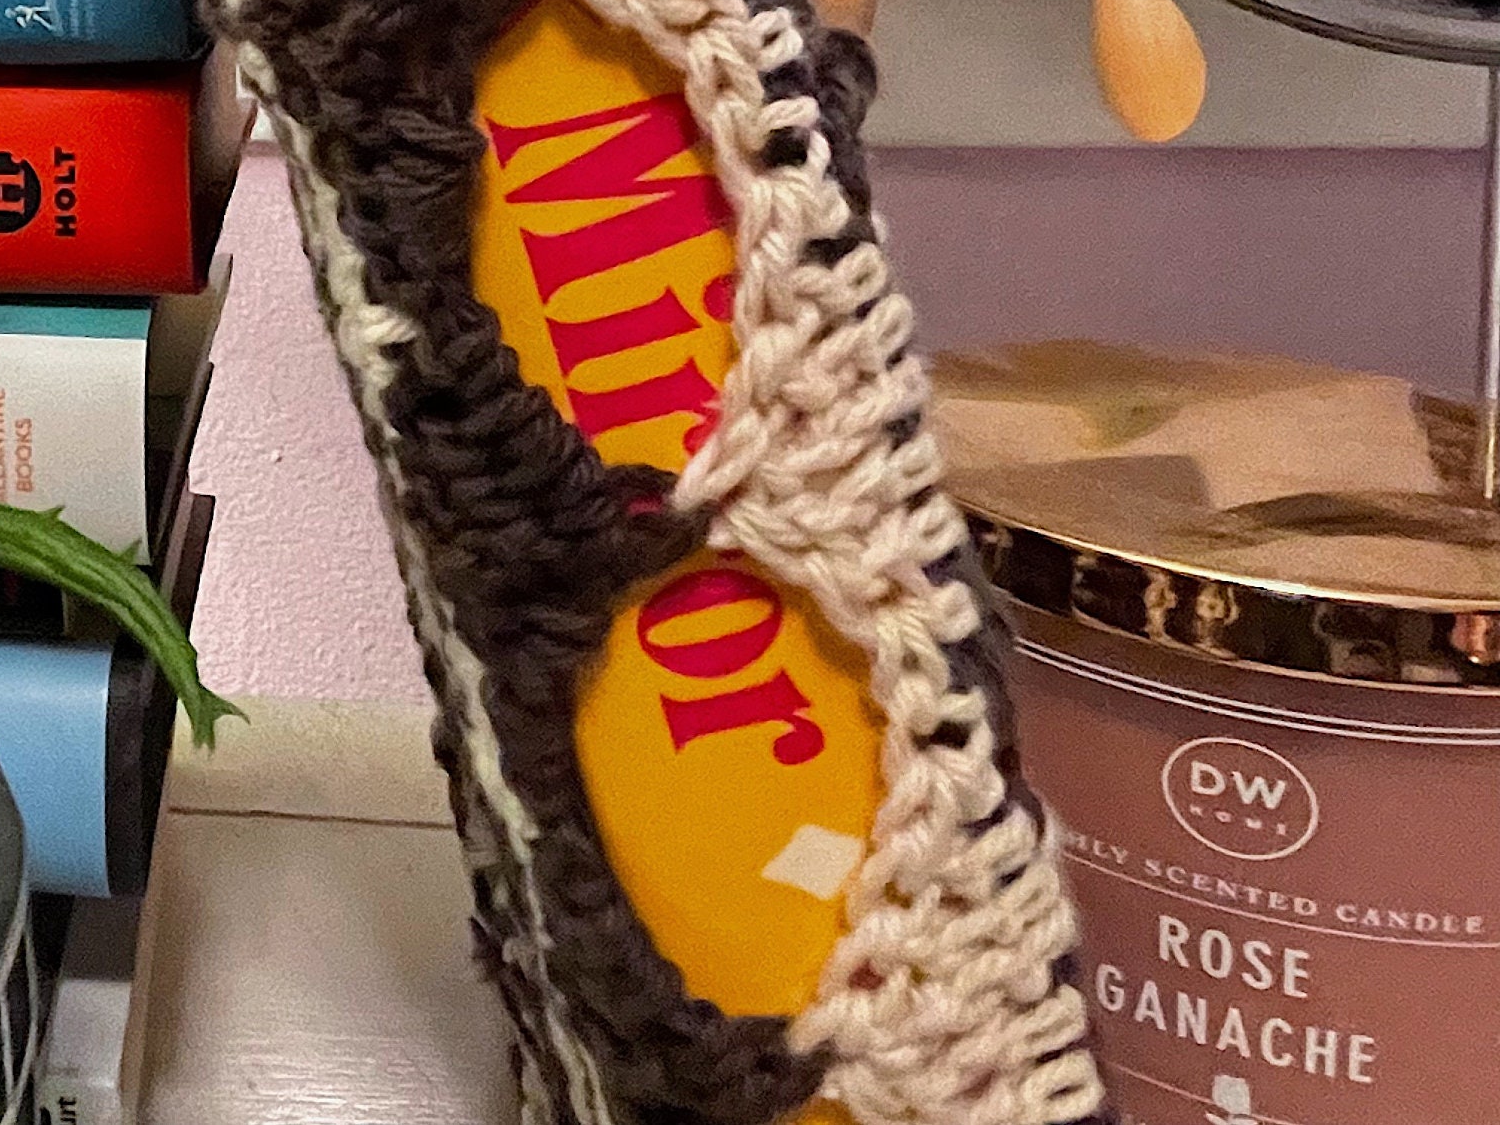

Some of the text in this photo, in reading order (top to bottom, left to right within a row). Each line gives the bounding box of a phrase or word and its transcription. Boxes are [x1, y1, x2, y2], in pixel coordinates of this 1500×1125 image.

[53, 146, 77, 237] HOLT
[15, 418, 33, 493] BOOKS
[1190, 760, 1288, 811] DW
[1145, 857, 1320, 918] SCENTED
[1336, 904, 1486, 936] CANDLE
[1158, 915, 1314, 1000] ROSE
[1096, 964, 1379, 1085] GANACHE
